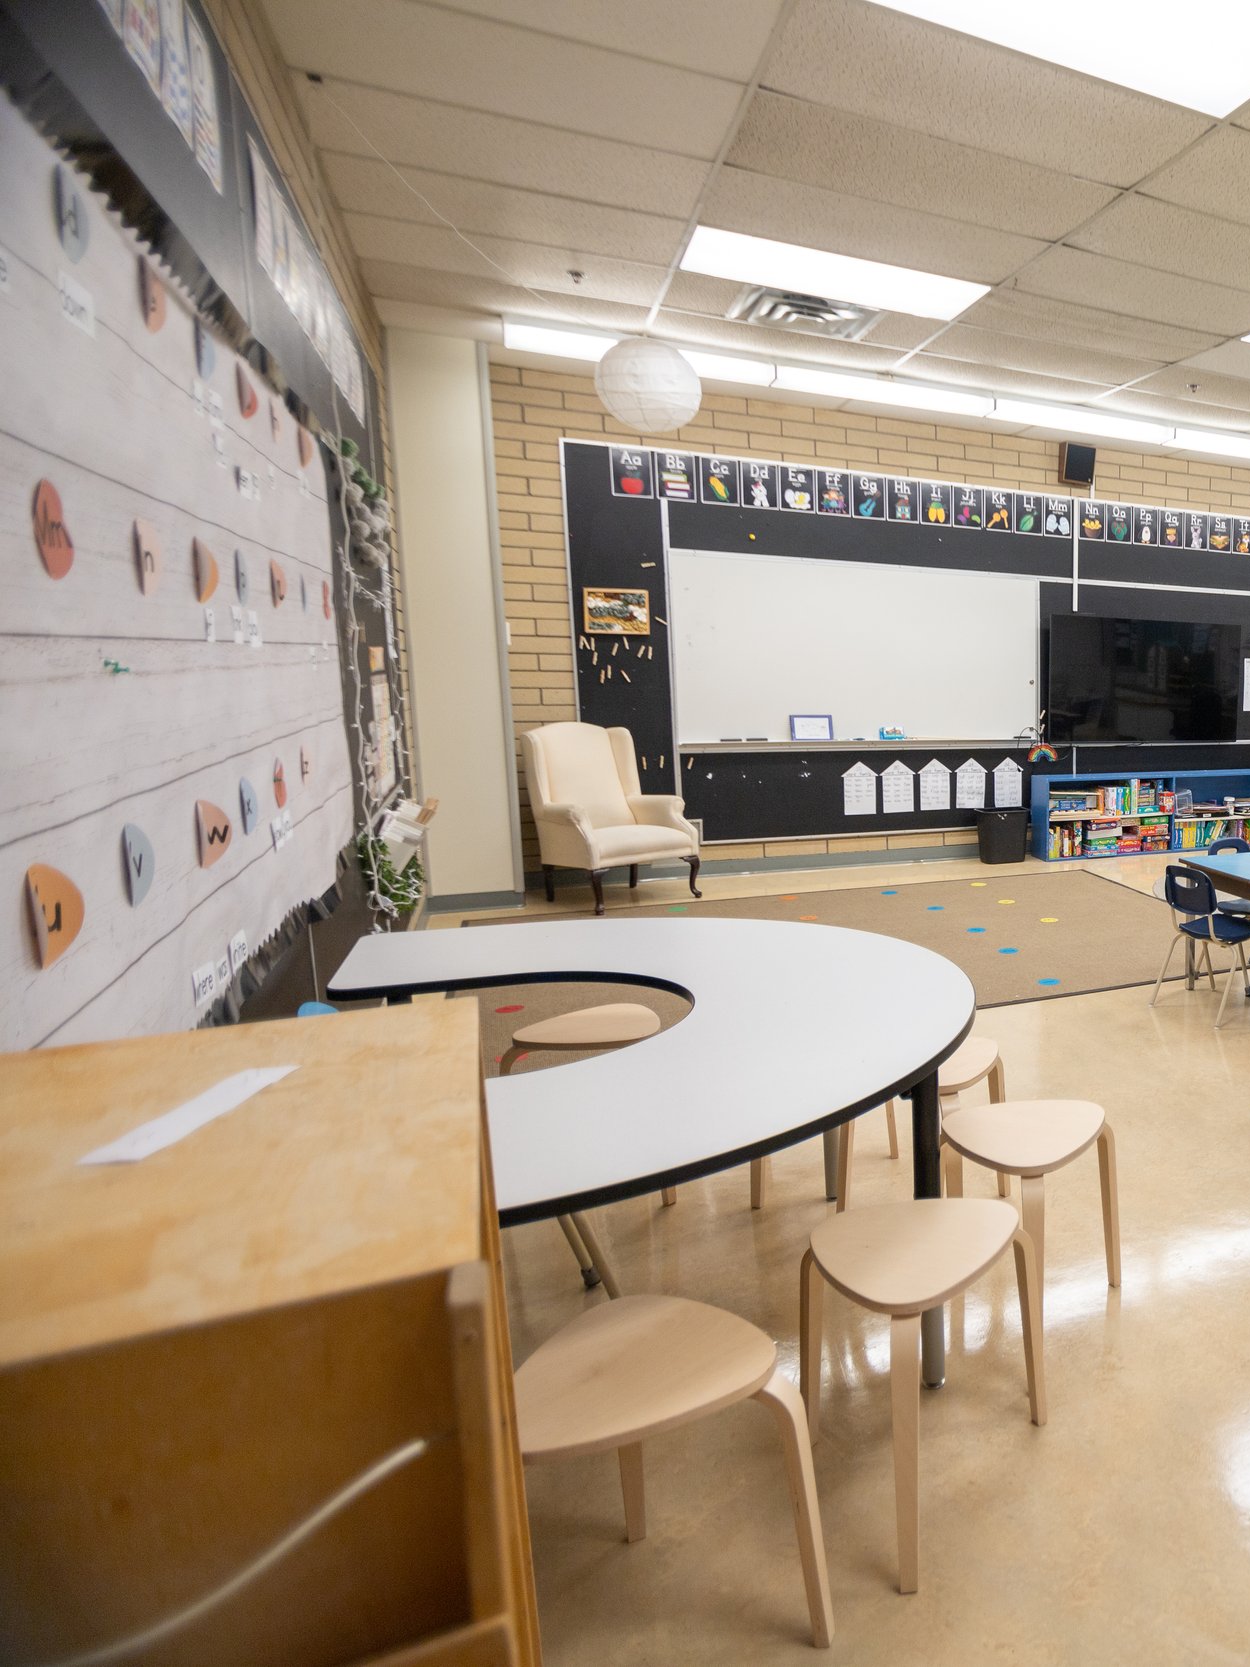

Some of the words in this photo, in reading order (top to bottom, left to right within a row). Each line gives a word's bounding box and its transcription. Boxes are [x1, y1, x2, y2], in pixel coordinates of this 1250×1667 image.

[621, 450, 642, 466] Aa
[665, 454, 686, 470] Bb
[710, 459, 730, 475] Cc
[750, 463, 769, 479] Dd
[788, 467, 806, 482] Ee
[825, 472, 841, 485] Ff
[860, 477, 877, 493] Gg
[894, 480, 911, 494] Hh
[930, 484, 942, 497] Ii
[962, 488, 974, 503] Jj
[991, 491, 1006, 505] Kk
[1023, 495, 1034, 508] Ll
[1048, 498, 1068, 512] Mm
[1085, 502, 1099, 515] Nn
[1140, 509, 1152, 521] Pp
[1165, 512, 1179, 526] Qq
[1190, 514, 1202, 526] Rr
[1239, 520, 1249, 530] Tt
